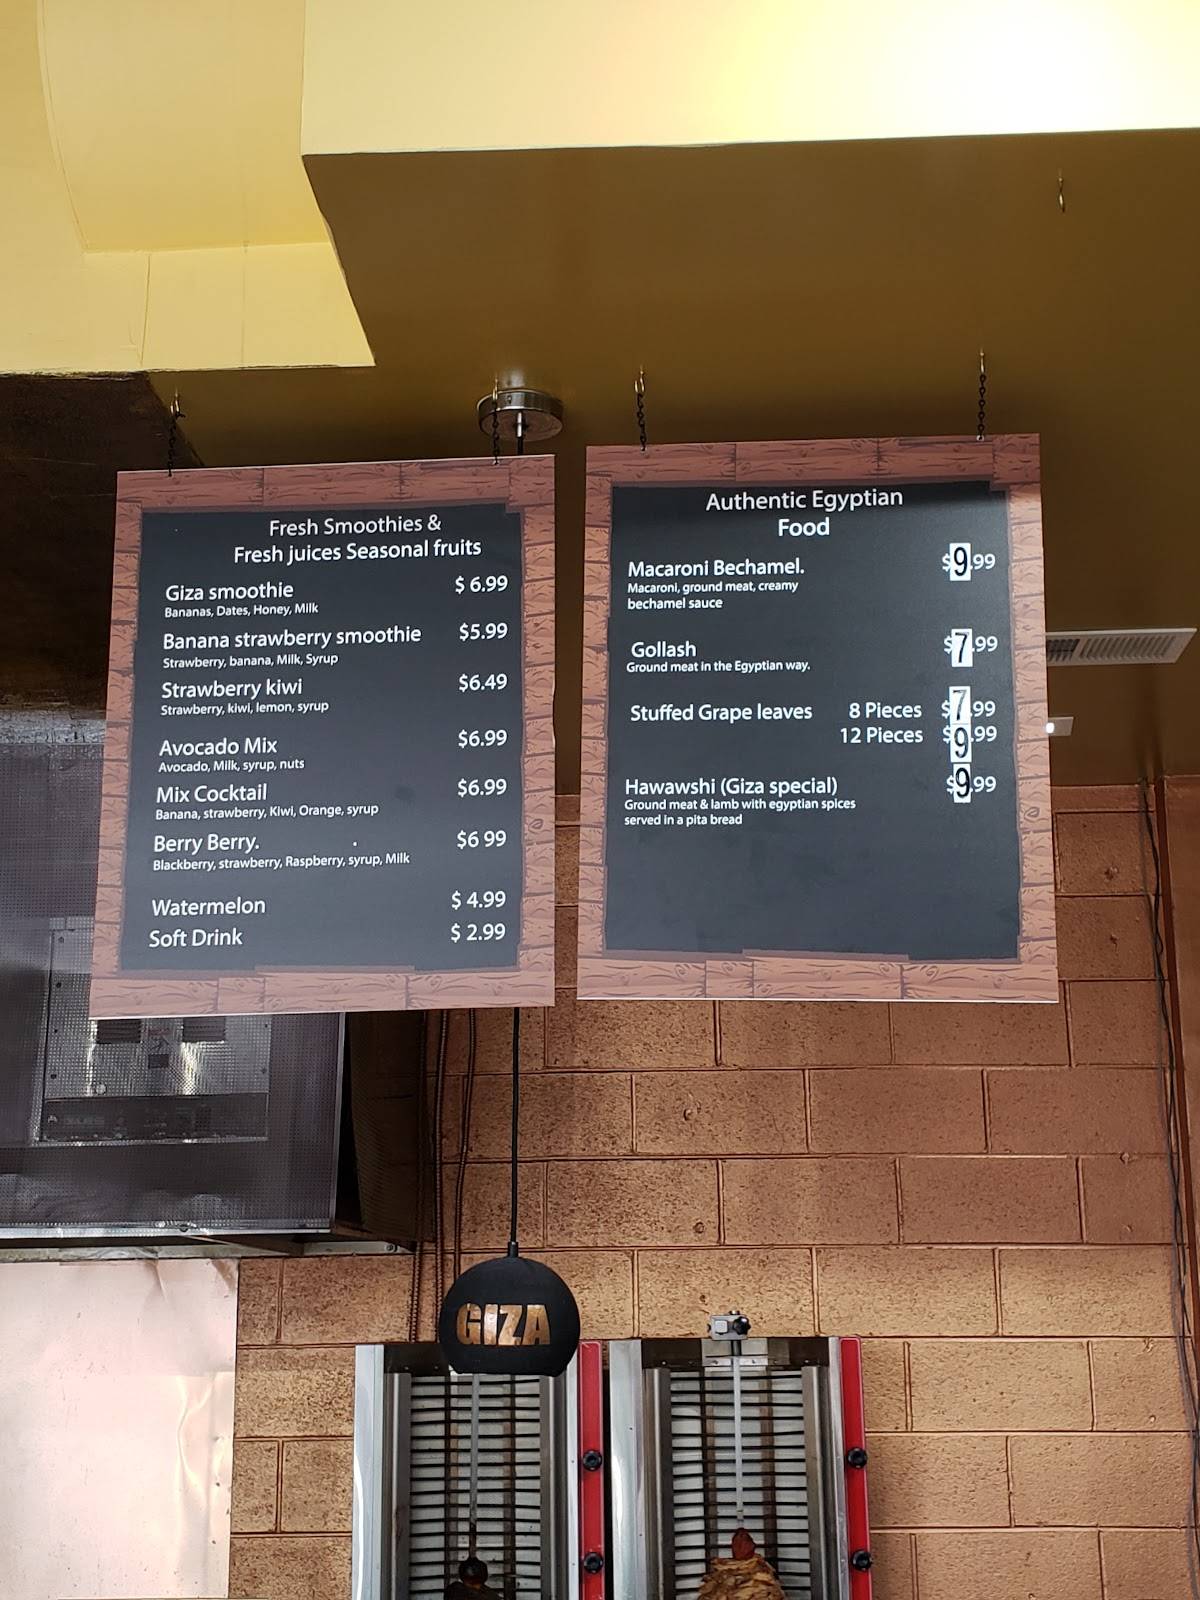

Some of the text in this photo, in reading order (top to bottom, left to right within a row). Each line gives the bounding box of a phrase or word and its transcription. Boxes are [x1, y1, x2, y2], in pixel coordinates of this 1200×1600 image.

[706, 489, 902, 512] Authentic Egyptian
[270, 514, 441, 536] Fresh Smoothies &
[779, 517, 829, 536] Food
[235, 539, 481, 565] Fresh juices Seasonal fruits
[629, 558, 804, 577] Macaroni Bechamel.
[166, 582, 293, 601] Giza smoothie
[628, 582, 798, 595] Macaroni, ground meat, creamy
[165, 603, 318, 617] Bananas, Dates, Honey, Milk
[628, 597, 723, 609] bechamel sauce
[164, 626, 421, 649] Banana strawberry smoothie
[460, 623, 507, 641] $5.99
[632, 641, 696, 657] Gollash
[163, 654, 338, 669] Strawberry, banana, Milk, Syrup
[627, 661, 810, 673] Ground meat in the Egyptian way.
[162, 679, 302, 700] Strawberry kiwi
[459, 674, 507, 692] $6.49
[161, 702, 328, 716] Strawberry, kiwi, lemon, syrup
[631, 703, 812, 723] Stuffed Grape leaves
[849, 702, 922, 718] 8 Pieces
[459, 729, 507, 748] $6.99
[841, 727, 923, 743] 12 Pieces
[159, 737, 277, 756] Avocado Mix
[159, 759, 304, 772] Avocado, Milk, syrup, nuts
[157, 783, 266, 803] Mix Cocktail
[458, 779, 506, 797] $6.99
[626, 777, 837, 797] Hawawshi (Giza special)
[156, 805, 378, 820] Banana, strawberry, Kiwi, Orange, syrup
[625, 798, 856, 811] Ground meat & lamb with egyptian spices
[625, 814, 742, 827] served in a pita bread
[154, 834, 259, 855] Berry Berry.
[154, 853, 409, 871] Blackberry, strawberry, Raspberry, syrup, Milk
[152, 897, 265, 916] Watermelon
[149, 928, 242, 947] Soft Drink
[456, 1303, 550, 1346] GIZA
